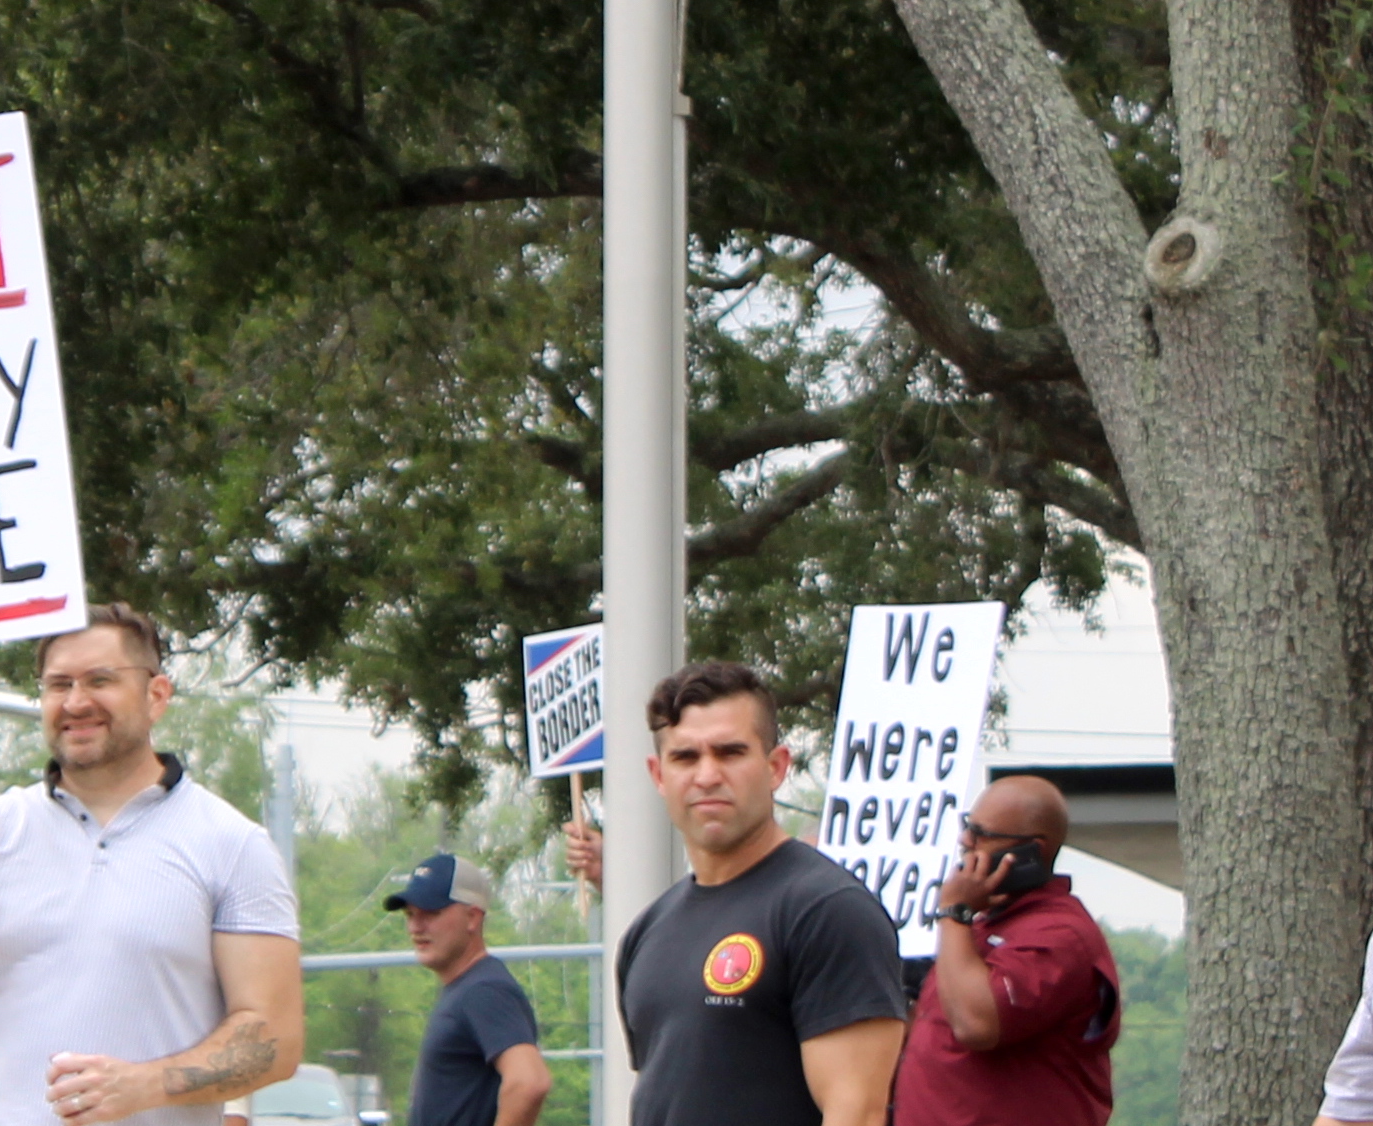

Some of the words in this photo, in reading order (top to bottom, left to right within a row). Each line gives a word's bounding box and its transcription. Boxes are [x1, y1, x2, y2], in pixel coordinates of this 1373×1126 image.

[528, 657, 572, 715] CLOSE
[573, 635, 600, 682] THE
[882, 611, 955, 685] We
[536, 676, 601, 763] BORDER
[840, 720, 958, 783] were
[824, 789, 957, 847] never
